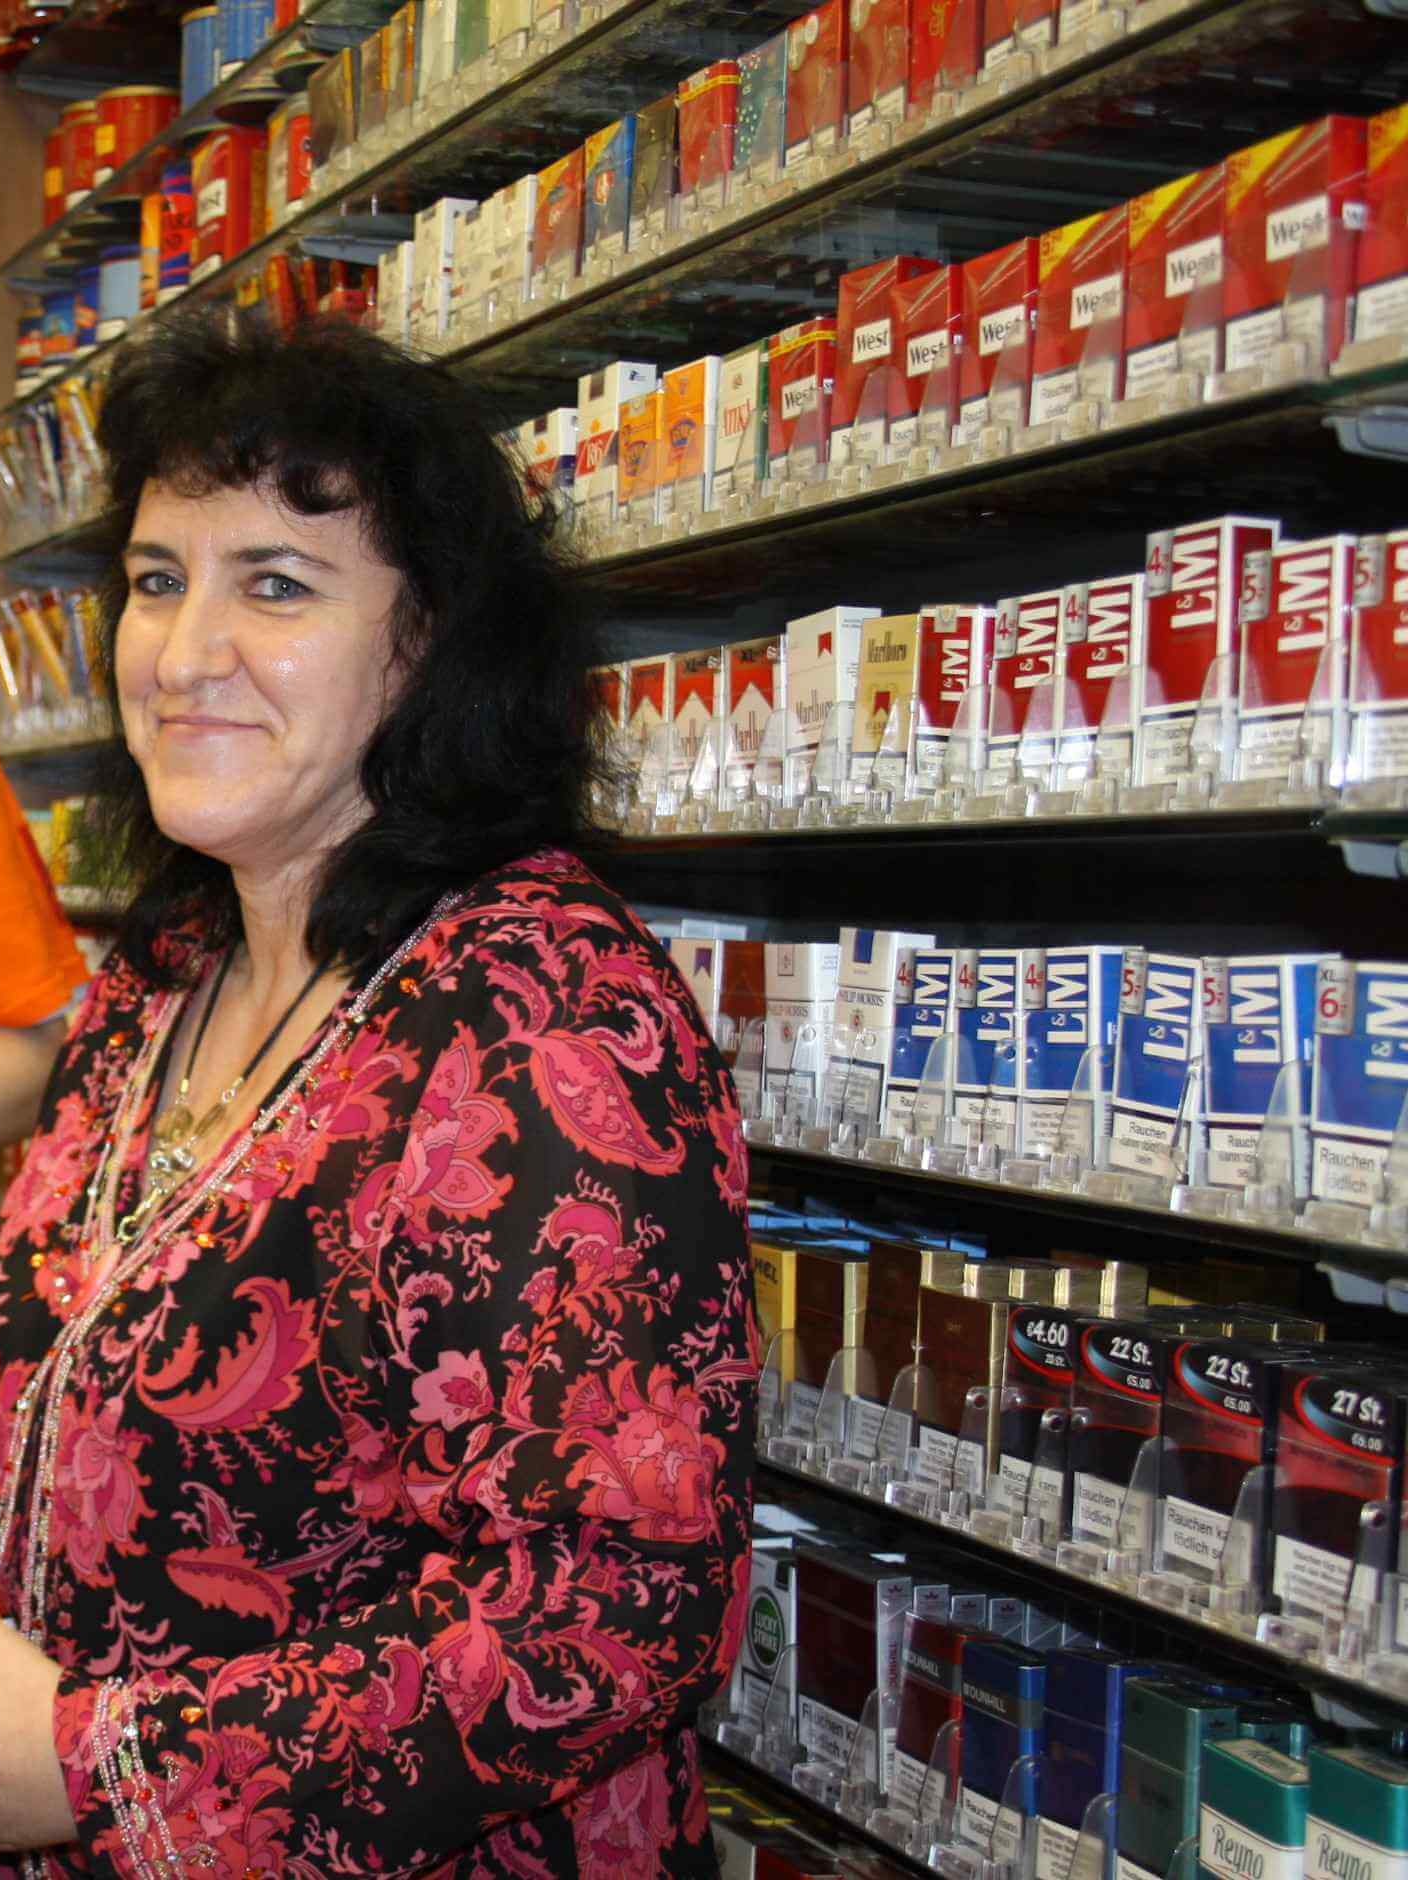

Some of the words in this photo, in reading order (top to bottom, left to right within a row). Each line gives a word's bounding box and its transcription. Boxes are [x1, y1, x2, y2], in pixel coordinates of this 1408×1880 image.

[1270, 211, 1326, 246] West
[855, 328, 889, 354] West
[981, 317, 1022, 343] West
[909, 342, 948, 366] West
[1169, 535, 1218, 630] L&M
[1277, 552, 1331, 653] L&M
[1013, 605, 1058, 689] L&M
[1085, 590, 1131, 680] L&M
[939, 639, 969, 702] L&M
[911, 963, 951, 1038] L&M
[976, 964, 1015, 1041] L&M
[1046, 961, 1088, 1044] L&M
[1142, 969, 1193, 1062] L&M
[1229, 973, 1282, 1064] L&M
[1128, 1120, 1168, 1140] Rauchen
[1227, 1135, 1258, 1149] Rauch
[1319, 1147, 1375, 1170] Rauchen
[1026, 1319, 1069, 1348] €4.60
[1109, 1335, 1131, 1360] 22
[1132, 1343, 1154, 1367] St.
[1205, 1354, 1230, 1380] 22
[1230, 1362, 1254, 1389] St.
[1330, 1389, 1355, 1417] 27
[1358, 1397, 1385, 1426] St.
[1168, 1507, 1214, 1535] Rauchen
[1174, 1531, 1210, 1558] tödlich
[754, 1610, 779, 1636] LUCKY
[1212, 1823, 1264, 1880] Reyno
[1318, 1833, 1372, 1880] Reyno
